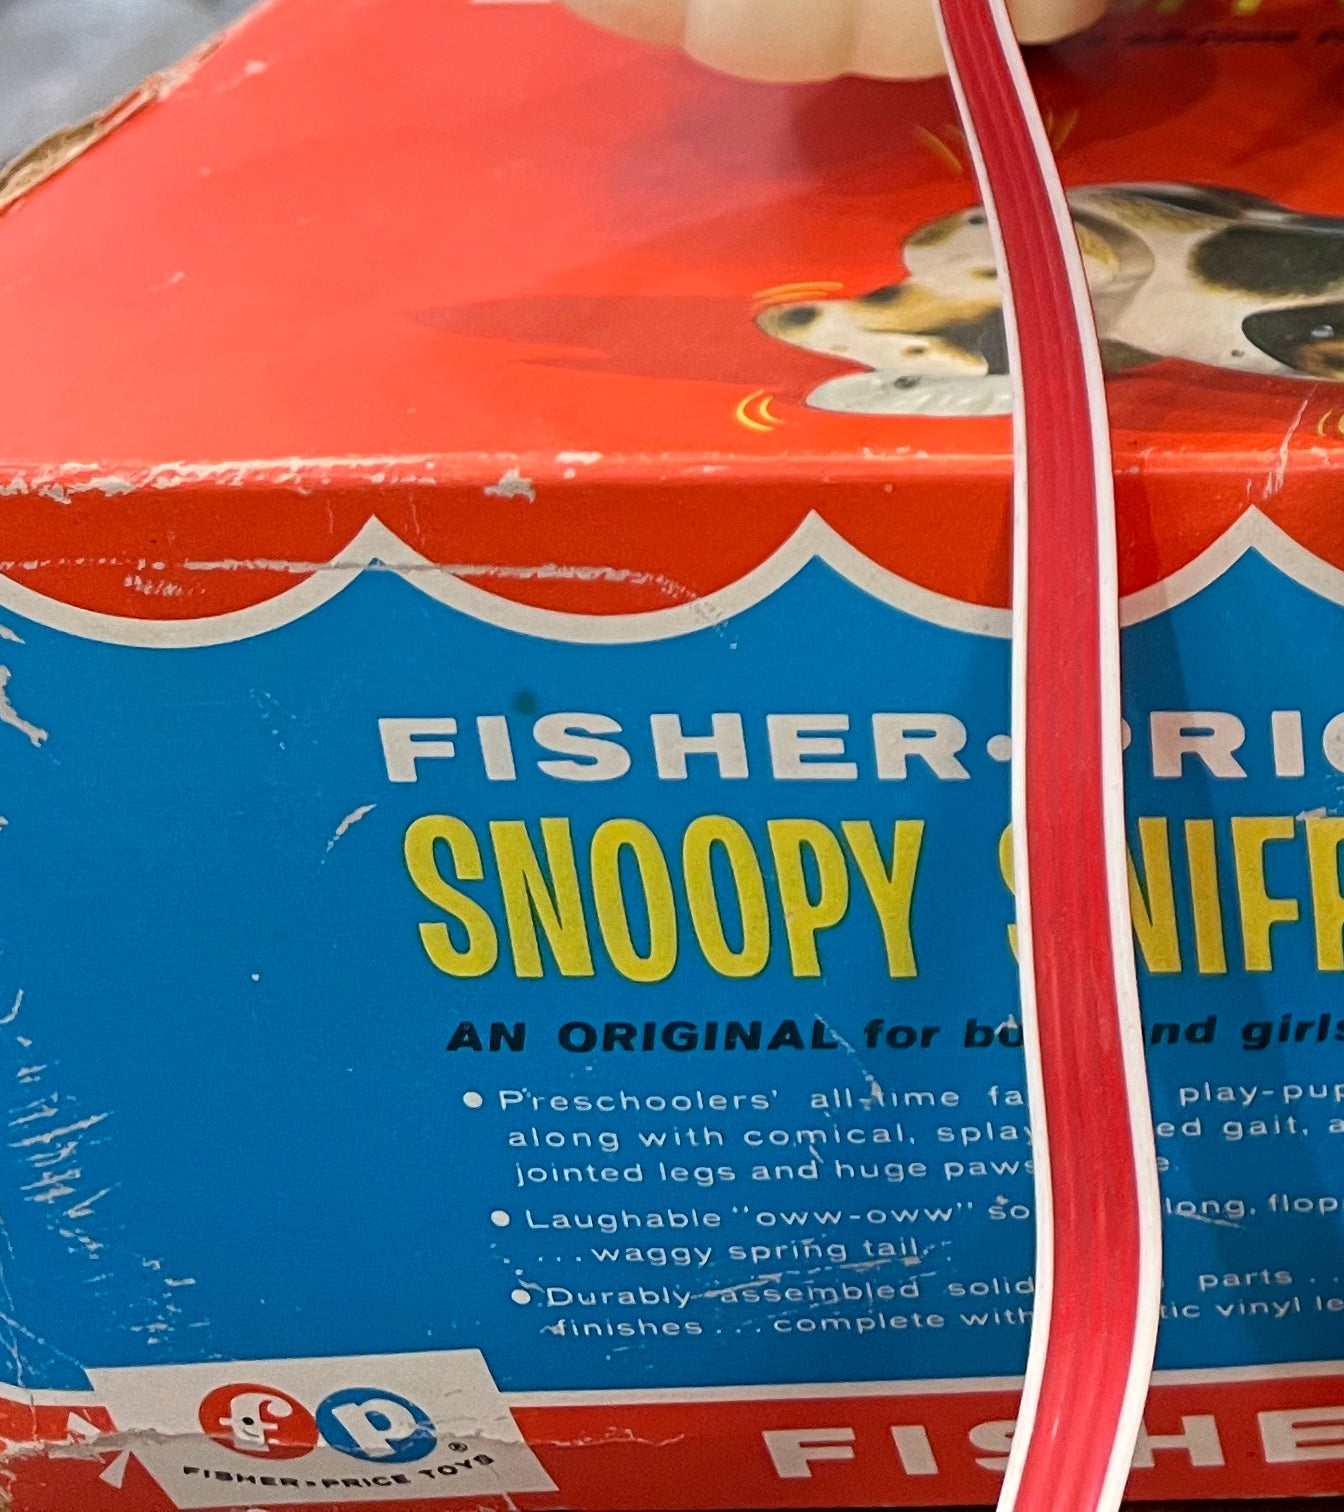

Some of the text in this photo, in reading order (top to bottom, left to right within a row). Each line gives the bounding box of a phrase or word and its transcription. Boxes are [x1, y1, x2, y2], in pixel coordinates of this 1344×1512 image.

[378, 712, 971, 782] FISHER
[404, 814, 925, 983] SNOOPY
[446, 1021, 526, 1053] AN
[557, 1019, 839, 1053] ORIGINAL
[864, 1018, 940, 1049] for
[964, 1018, 1023, 1048] bo
[1149, 1014, 1217, 1045] nd
[508, 1127, 620, 1152] along
[638, 1126, 724, 1147] with
[515, 1161, 644, 1187] jointed
[659, 1162, 736, 1187] legs
[751, 1159, 819, 1182] and
[835, 1158, 928, 1183] huge
[526, 1209, 722, 1234] Laughable
[728, 1240, 848, 1264] spring
[547, 1285, 692, 1309] Durably
[720, 1281, 920, 1304] assembled
[947, 1275, 1034, 1297] solid
[1198, 1268, 1294, 1292] parts
[551, 1317, 704, 1337] finishes
[773, 1311, 946, 1335] complete
[959, 1306, 1034, 1327] with
[1214, 1297, 1303, 1320] vinyl
[183, 1454, 495, 1489] FISHER PRICE TOYS
